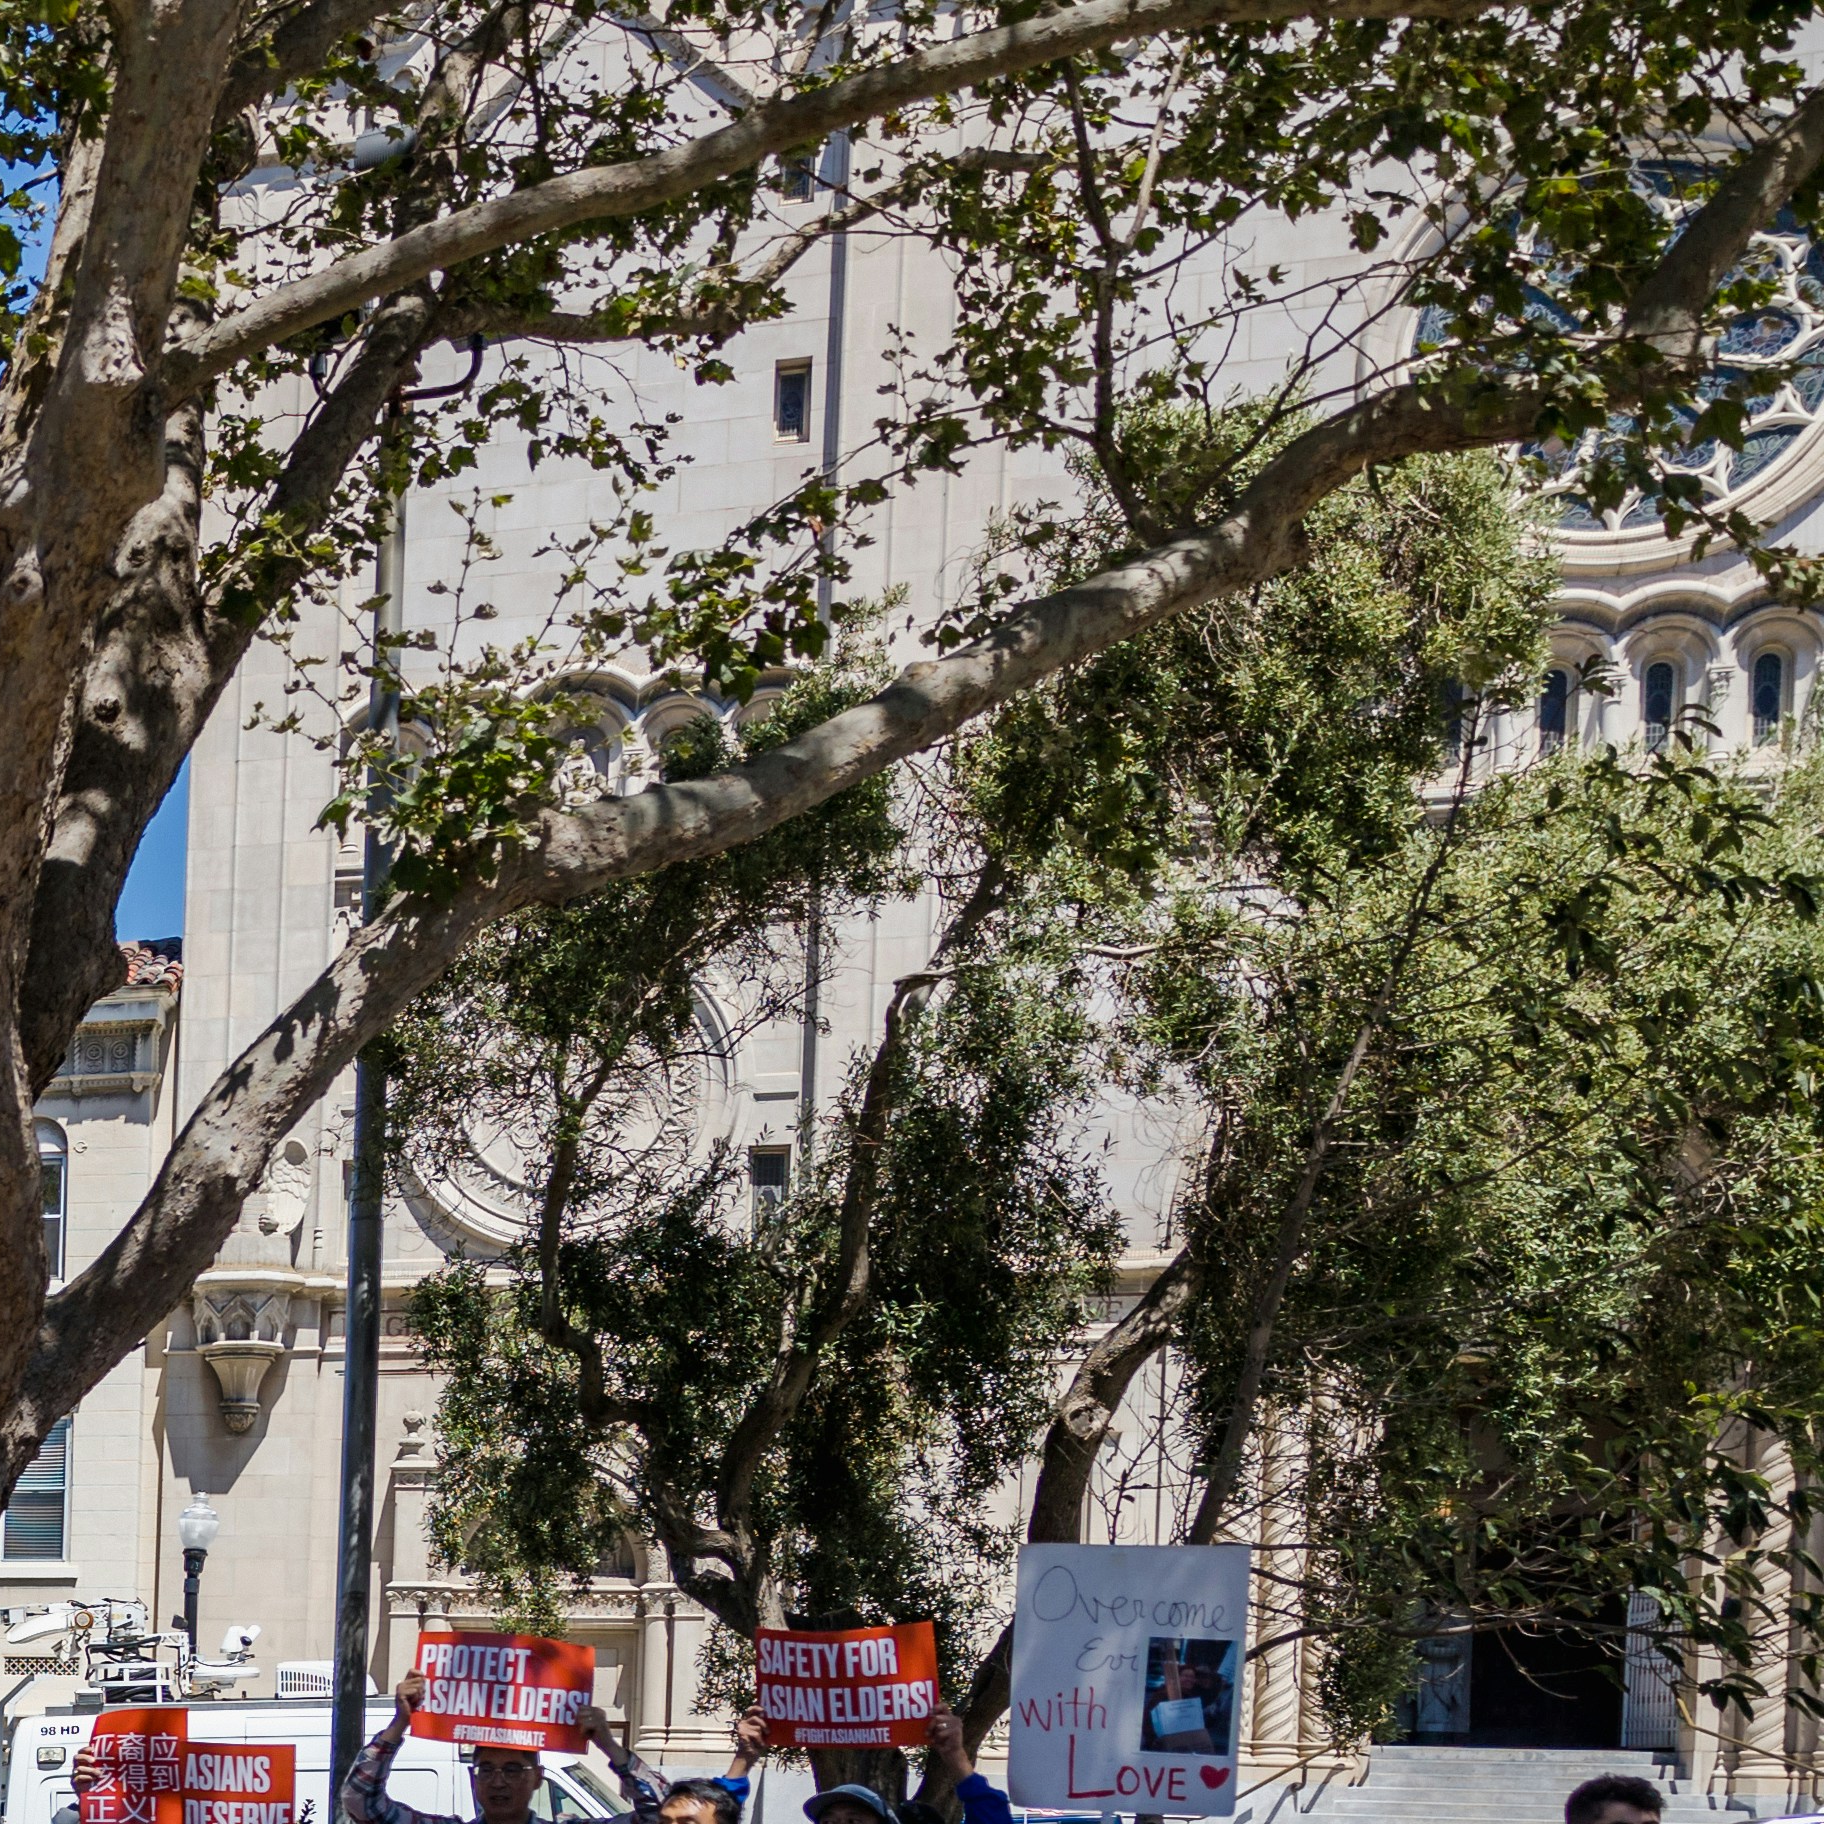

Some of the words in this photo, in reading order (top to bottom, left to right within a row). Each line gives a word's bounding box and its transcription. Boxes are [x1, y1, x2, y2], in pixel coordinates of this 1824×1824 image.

[1032, 1565, 1233, 1632] Overcome
[420, 1643, 532, 1684] PROTECT
[759, 1637, 840, 1679] SAFETY
[844, 1637, 898, 1679] FOR
[1076, 1637, 1139, 1673] Evi
[417, 1678, 488, 1718] ASIAN
[760, 1683, 825, 1723] ASIAN
[828, 1679, 934, 1723] ELDERS!
[1018, 1686, 1108, 1732] with
[40, 1726, 56, 1736] 98
[60, 1725, 80, 1735] HD
[91, 1732, 180, 1762] 亚裔应
[453, 1724, 546, 1748] #FIGHTASIANHATE
[794, 1727, 891, 1744] #FIGHTASIANHATE
[184, 1753, 271, 1794] ASIANS
[85, 1794, 157, 1824] 正义!
